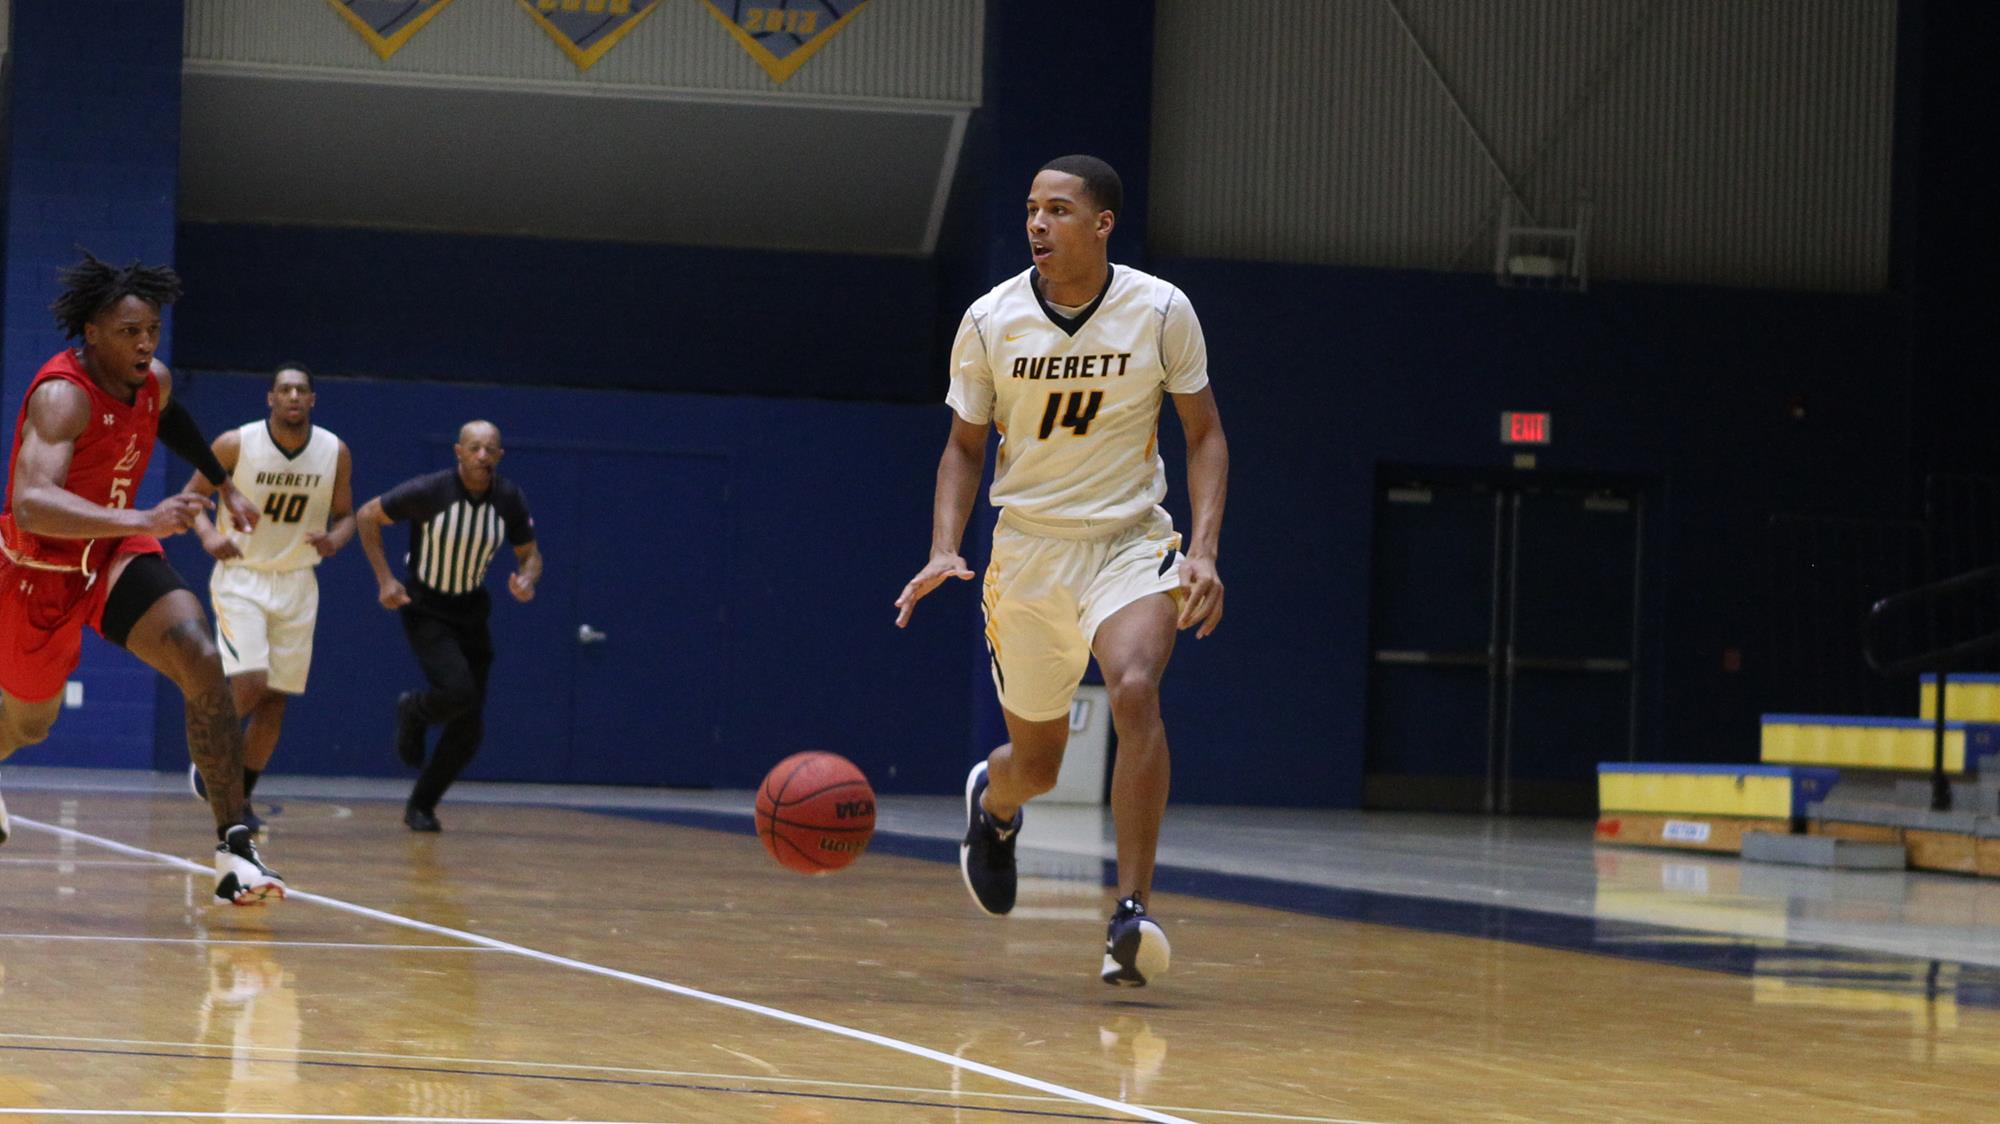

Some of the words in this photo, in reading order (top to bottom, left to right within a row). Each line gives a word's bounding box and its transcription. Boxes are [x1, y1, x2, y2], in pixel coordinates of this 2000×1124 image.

[746, 8, 817, 33] 2013
[1013, 353, 1131, 379] AVERETT
[1039, 391, 1104, 439] 14
[1511, 413, 1544, 442] EXIT
[107, 477, 132, 510] 5
[255, 472, 322, 487] AVERETT
[263, 493, 310, 522] 40
